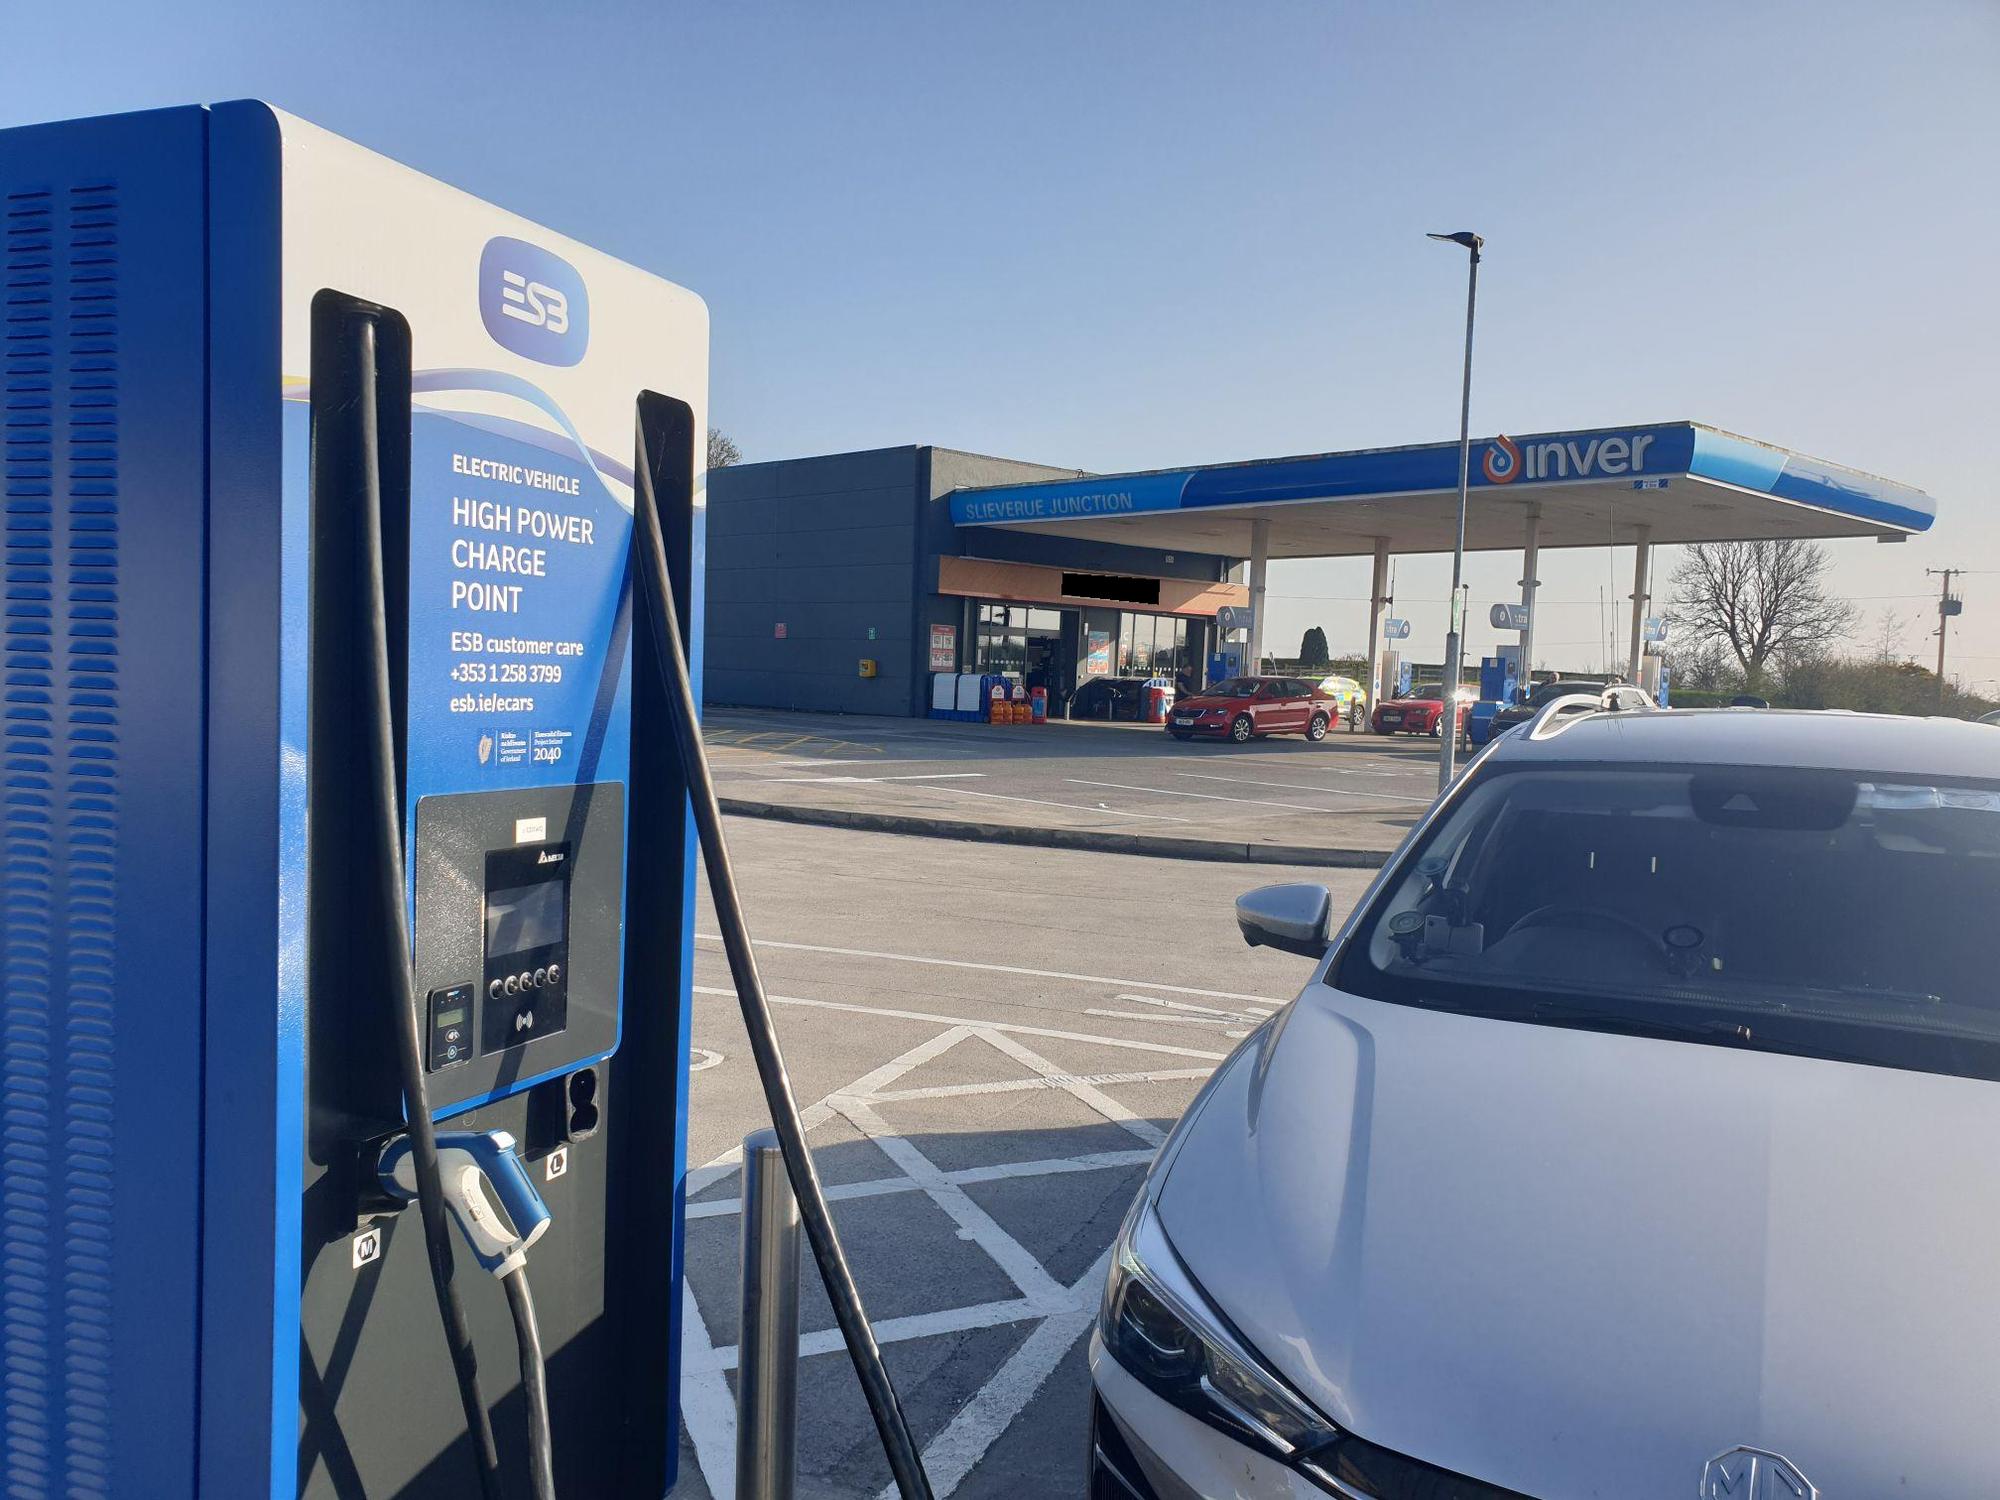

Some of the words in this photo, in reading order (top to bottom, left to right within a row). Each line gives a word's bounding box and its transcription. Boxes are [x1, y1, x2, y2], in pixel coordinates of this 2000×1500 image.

[502, 270, 568, 334] ESB
[1526, 435, 1655, 478] inver
[453, 454, 523, 484] ELECTRIC
[524, 469, 580, 495] VEHICLE
[966, 499, 1045, 519] SLIEVERUE
[1050, 492, 1133, 514] JUNCTION
[453, 497, 511, 532] HIGH
[517, 508, 594, 545] POWER
[452, 539, 546, 577] CHARGE
[452, 581, 523, 613] POINT
[451, 631, 483, 652] ESB
[486, 637, 553, 655] customer
[556, 642, 584, 656] care
[451, 663, 486, 682] +353
[490, 664, 498, 682] 1
[501, 664, 526, 683] 258
[529, 665, 562, 683] 3799
[450, 693, 534, 713] esb.ie/ecars
[534, 747, 561, 764] 2040
[361, 1239, 373, 1258] M
